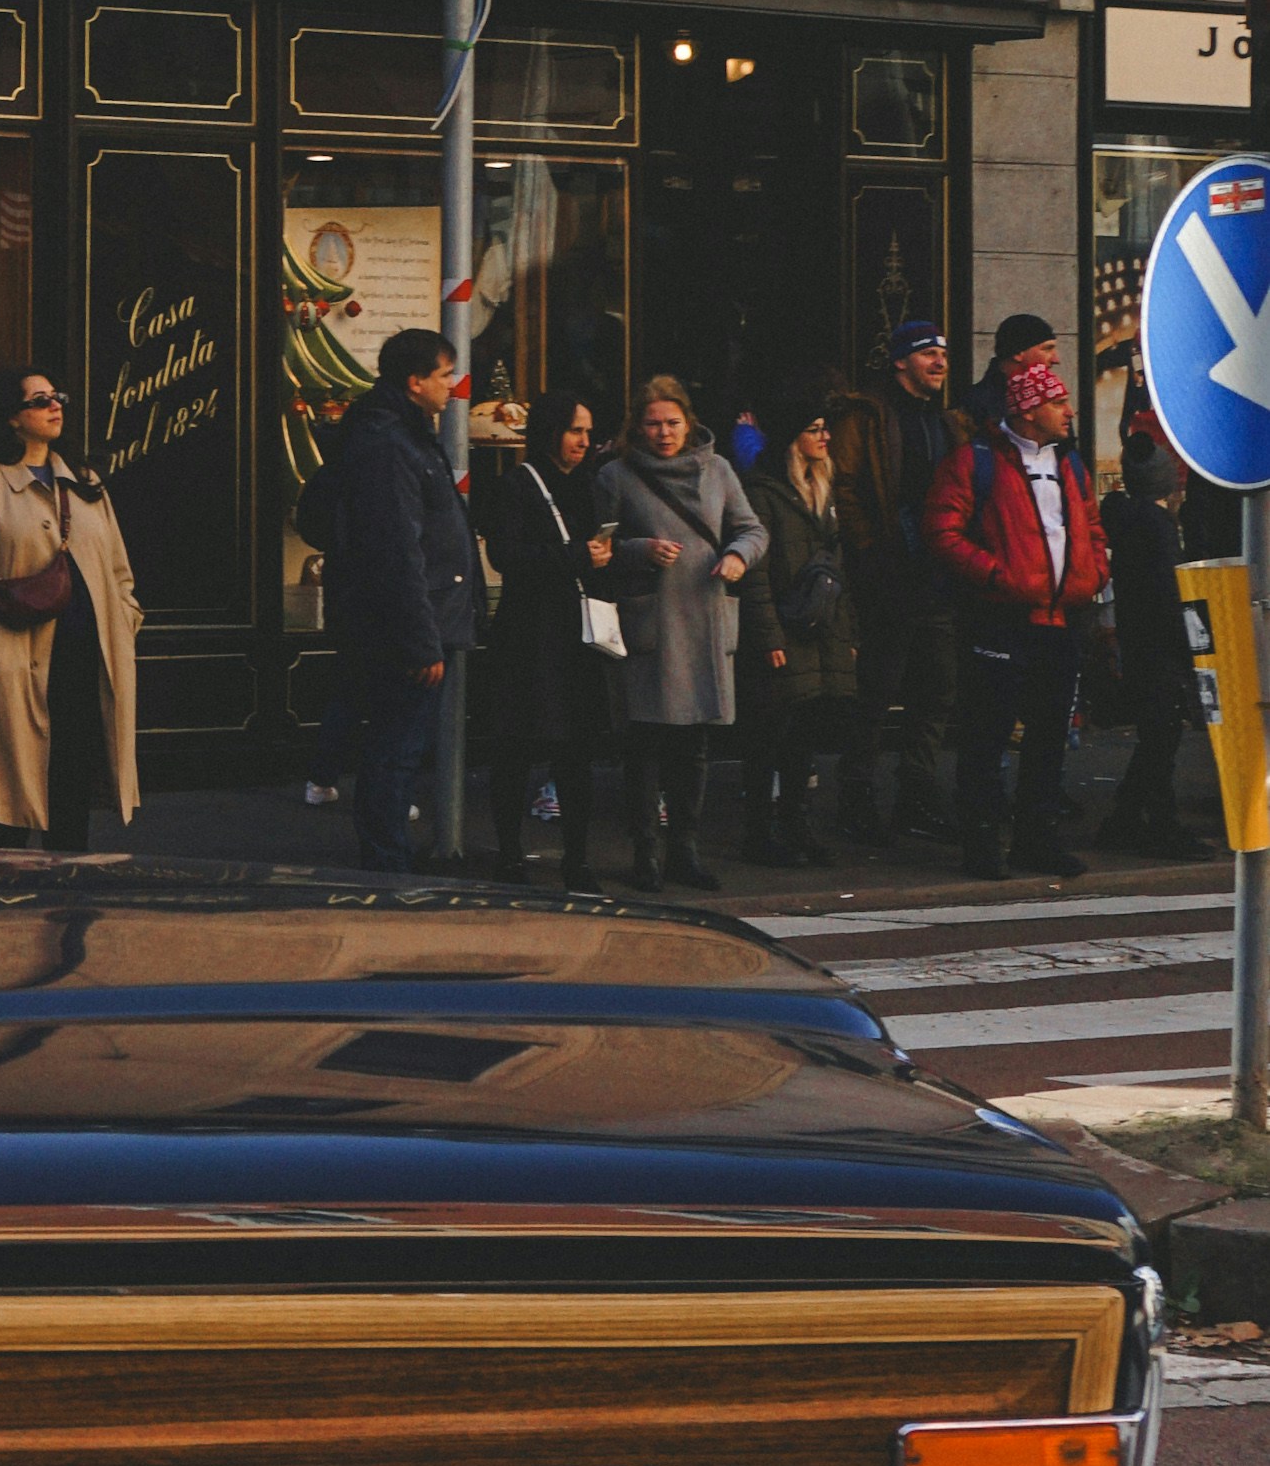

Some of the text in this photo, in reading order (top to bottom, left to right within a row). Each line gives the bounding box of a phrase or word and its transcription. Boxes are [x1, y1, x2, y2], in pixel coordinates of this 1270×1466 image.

[117, 287, 198, 347] Casa
[106, 329, 217, 440] fondata
[110, 388, 218, 474] nel 1824
